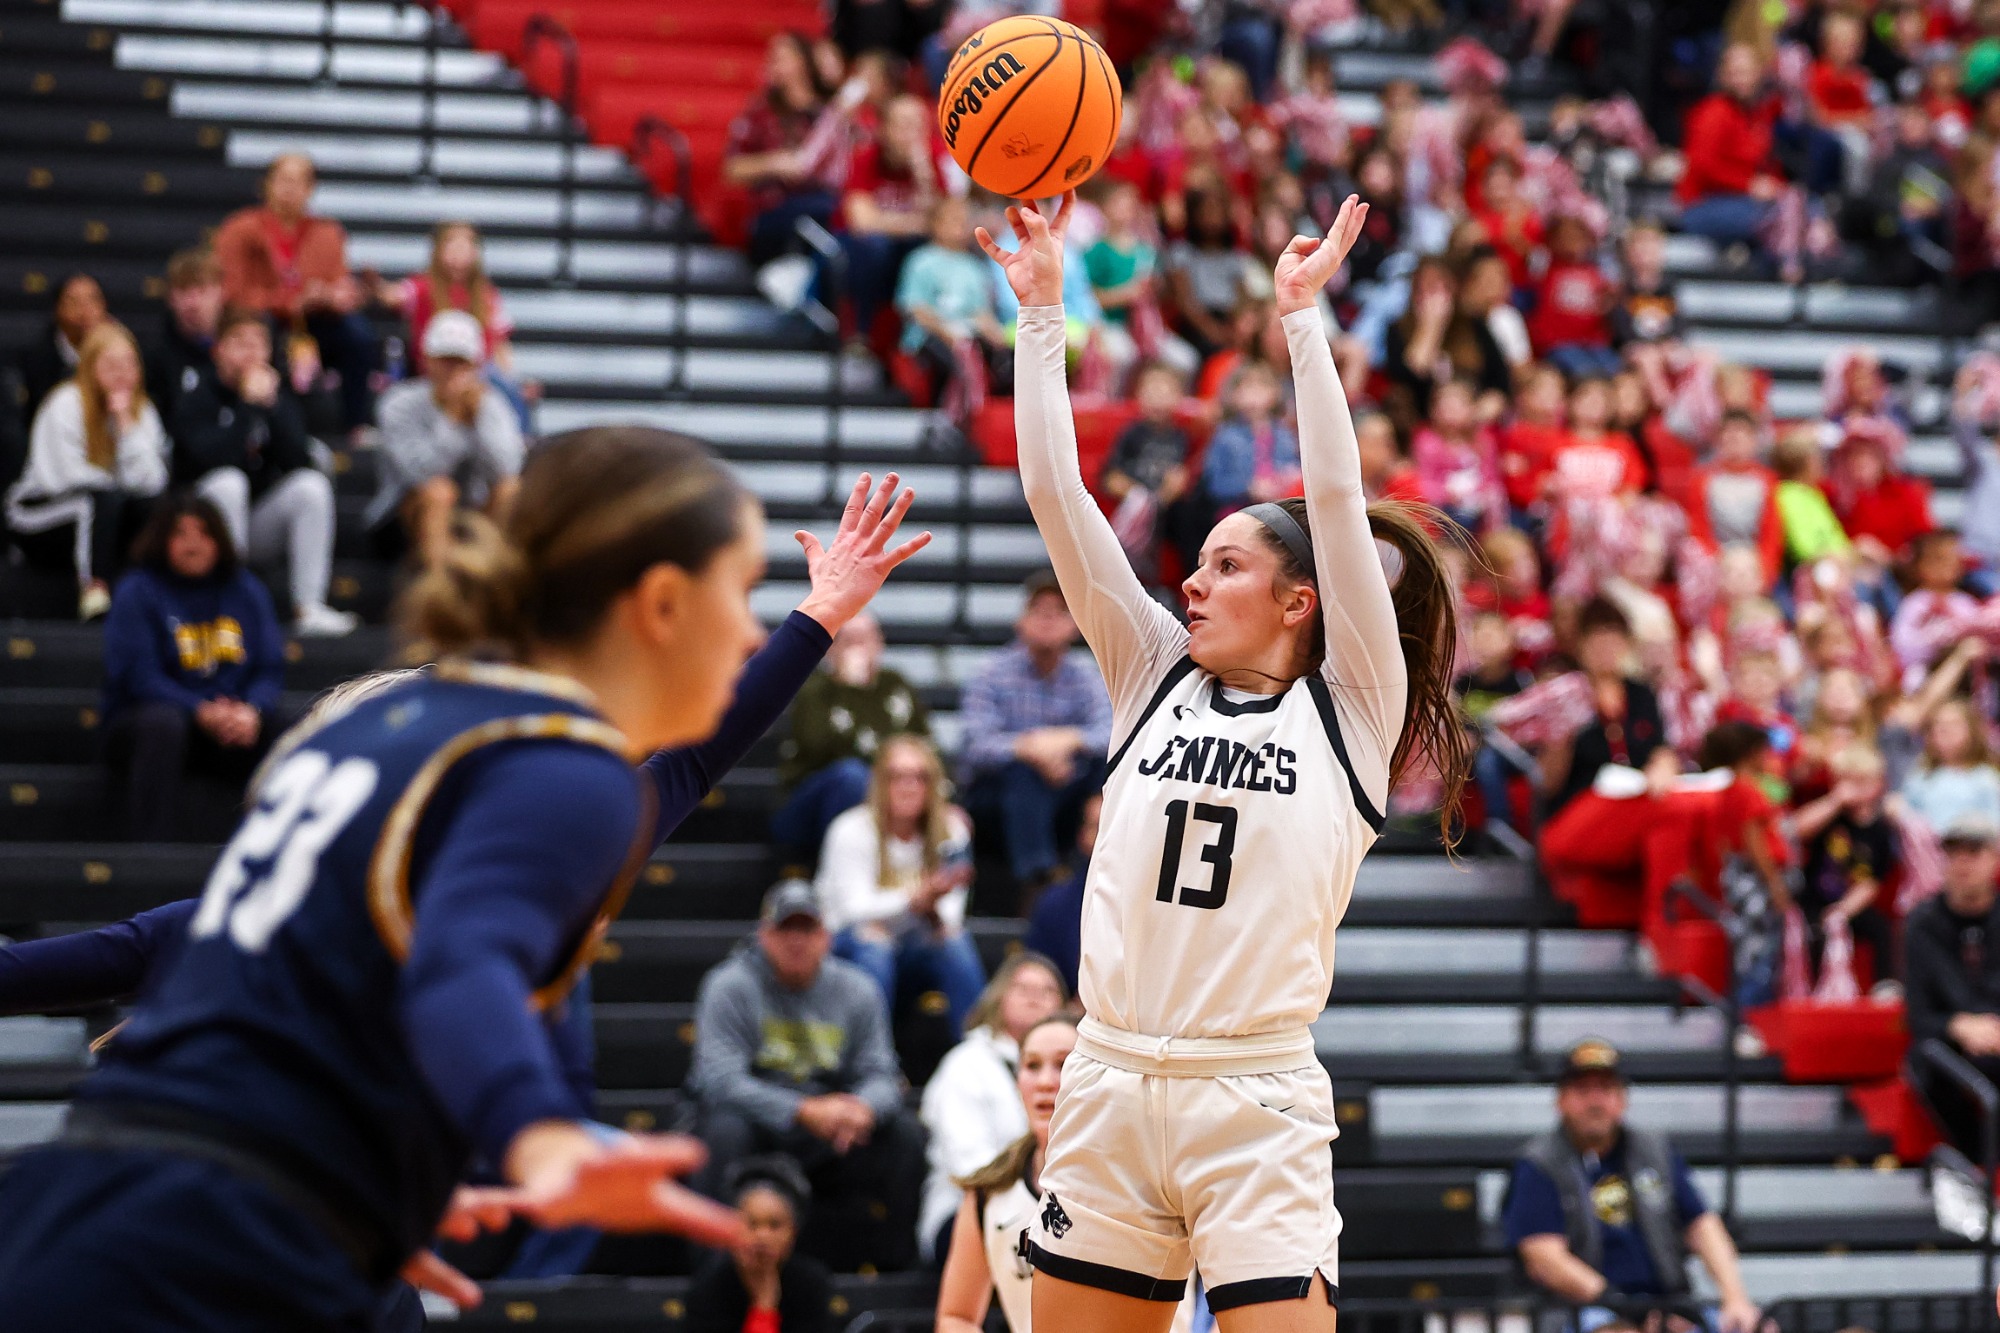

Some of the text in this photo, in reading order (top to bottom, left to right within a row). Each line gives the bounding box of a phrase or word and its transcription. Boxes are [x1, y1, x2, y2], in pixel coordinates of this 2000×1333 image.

[944, 51, 1027, 150] Wilson
[1138, 735, 1297, 796] JENNIES
[1155, 799, 1239, 910] 13
